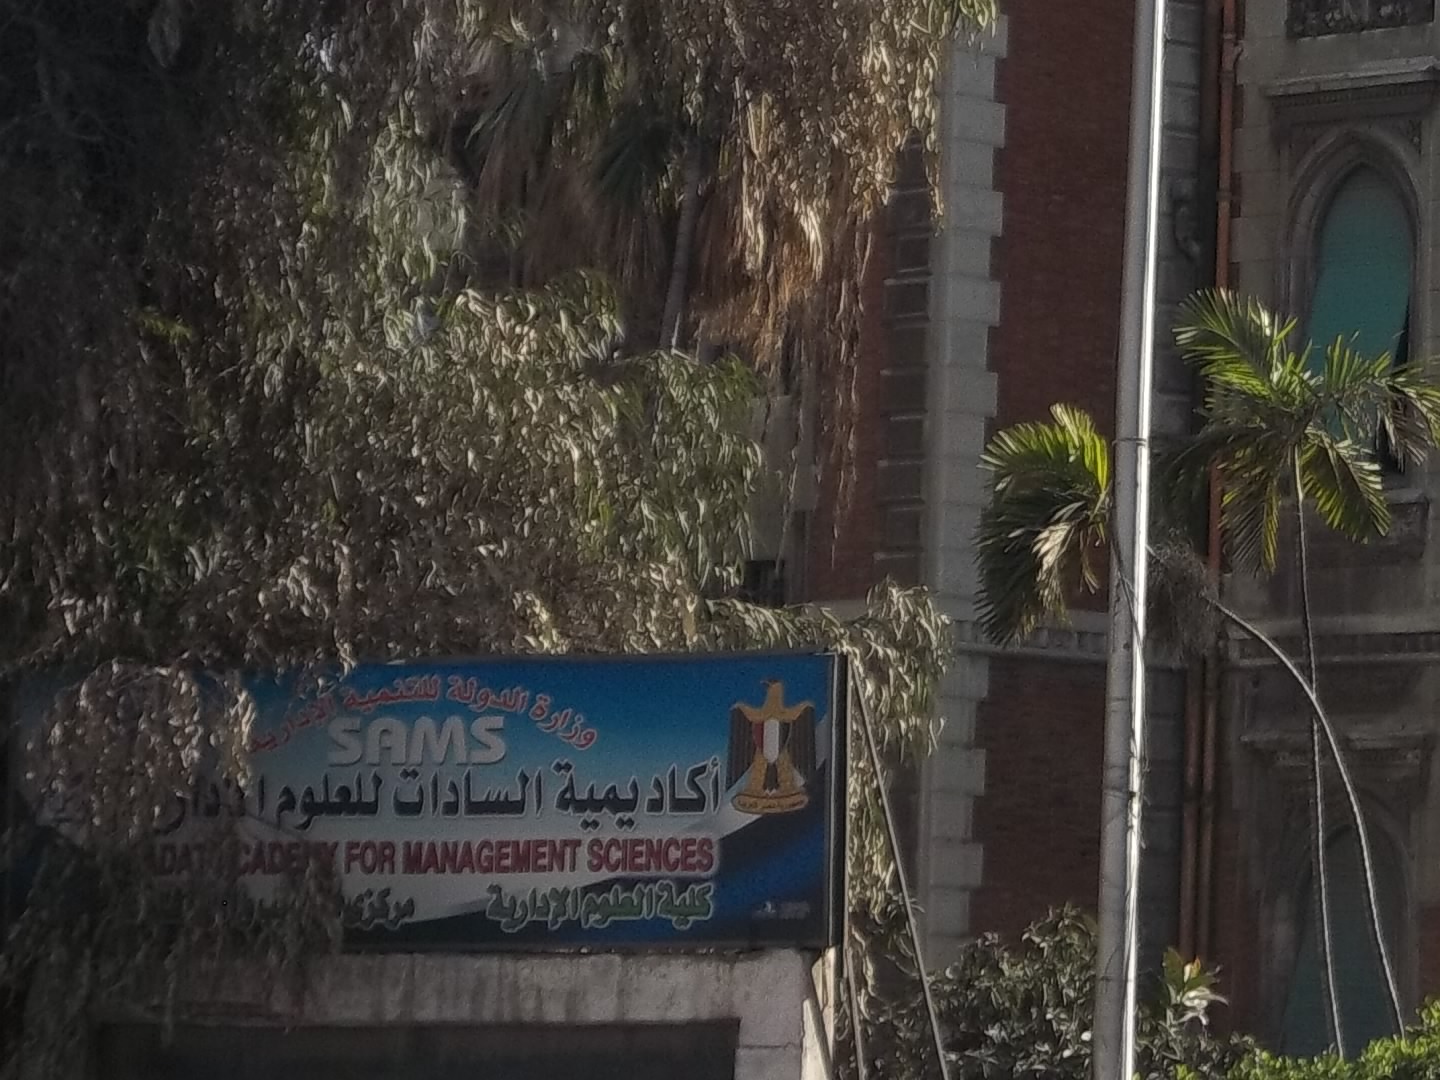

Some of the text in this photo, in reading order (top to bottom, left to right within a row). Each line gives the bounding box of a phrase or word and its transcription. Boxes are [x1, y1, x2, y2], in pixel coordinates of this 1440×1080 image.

[447, 674, 529, 713] الدولة
[327, 715, 507, 767] SAMS
[530, 692, 599, 751] وزارة
[275, 769, 384, 831] للعلوم
[393, 766, 544, 818] السادات
[552, 756, 722, 832] أكاديمية
[344, 840, 396, 875] FOR
[402, 839, 578, 875] MANAGEMENT
[587, 838, 714, 873] SCIENCES
[580, 884, 656, 929] العلوم
[656, 879, 713, 930] كلية
